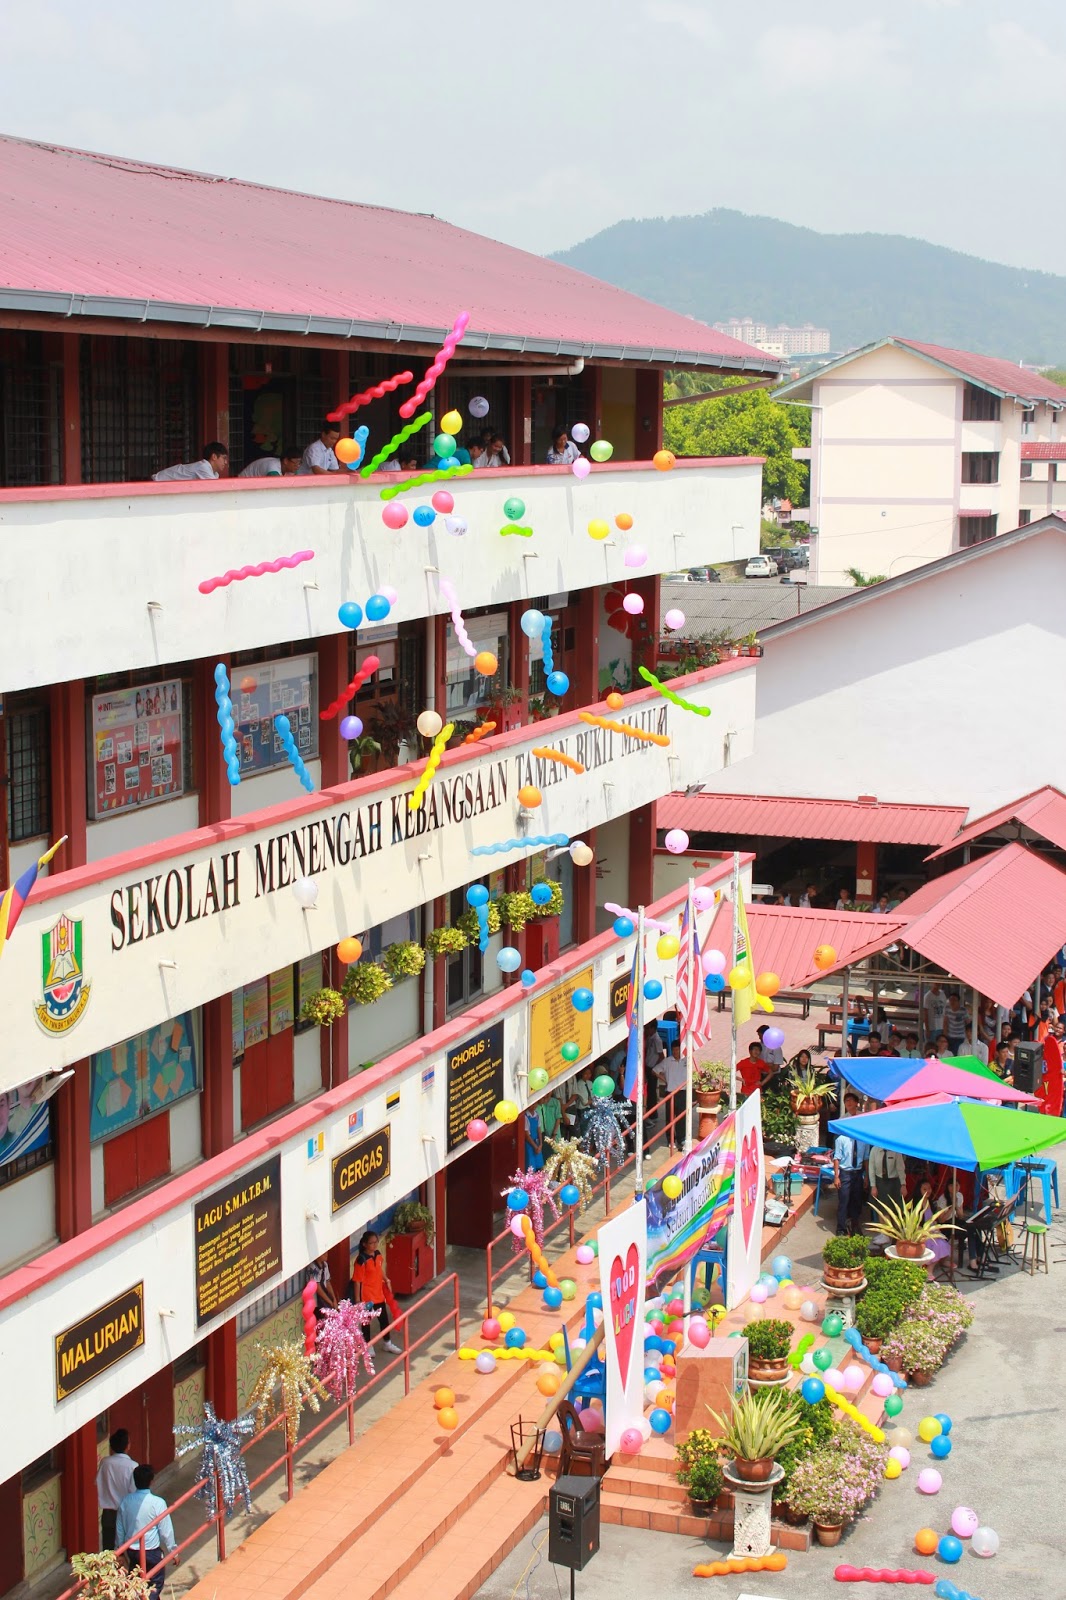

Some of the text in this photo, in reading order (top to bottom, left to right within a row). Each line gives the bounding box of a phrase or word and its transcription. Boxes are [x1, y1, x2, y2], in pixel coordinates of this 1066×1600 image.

[111, 851, 241, 953] SEKOLAH
[254, 801, 383, 898] MENENGAH
[390, 759, 508, 846] KEBANGSAAN
[515, 738, 569, 799] TAMAN
[576, 724, 613, 772] BUKIT
[451, 1040, 485, 1069] CHORUS
[340, 1145, 383, 1191] CERGAS
[701, 1142, 720, 1181] Bakti
[197, 1175, 272, 1233] LAGU S.M.K.T.B.M.
[615, 1297, 635, 1335] LUCK
[61, 1305, 138, 1377] MALURIAN
[560, 1500, 572, 1512] JBL
